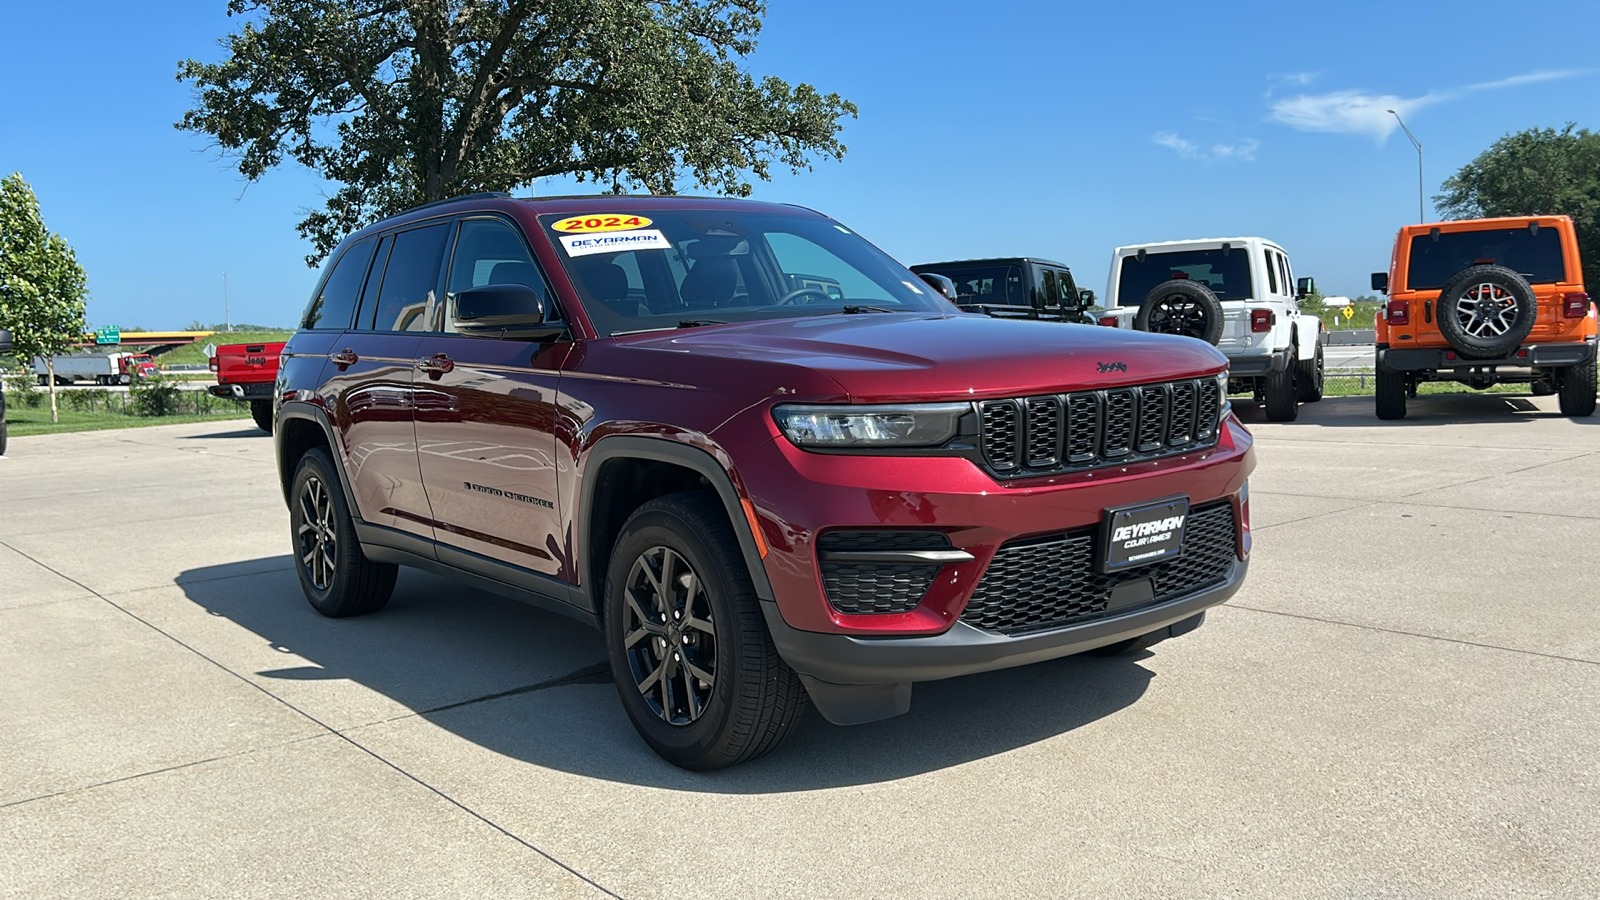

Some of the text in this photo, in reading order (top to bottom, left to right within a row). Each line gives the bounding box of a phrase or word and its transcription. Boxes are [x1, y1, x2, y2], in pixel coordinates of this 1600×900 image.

[565, 217, 642, 230] 2024
[571, 235, 658, 247] DEYARMAN
[245, 355, 267, 367] Jeep
[1096, 361, 1127, 373] Jeep
[1112, 515, 1185, 542] DEYARMAN
